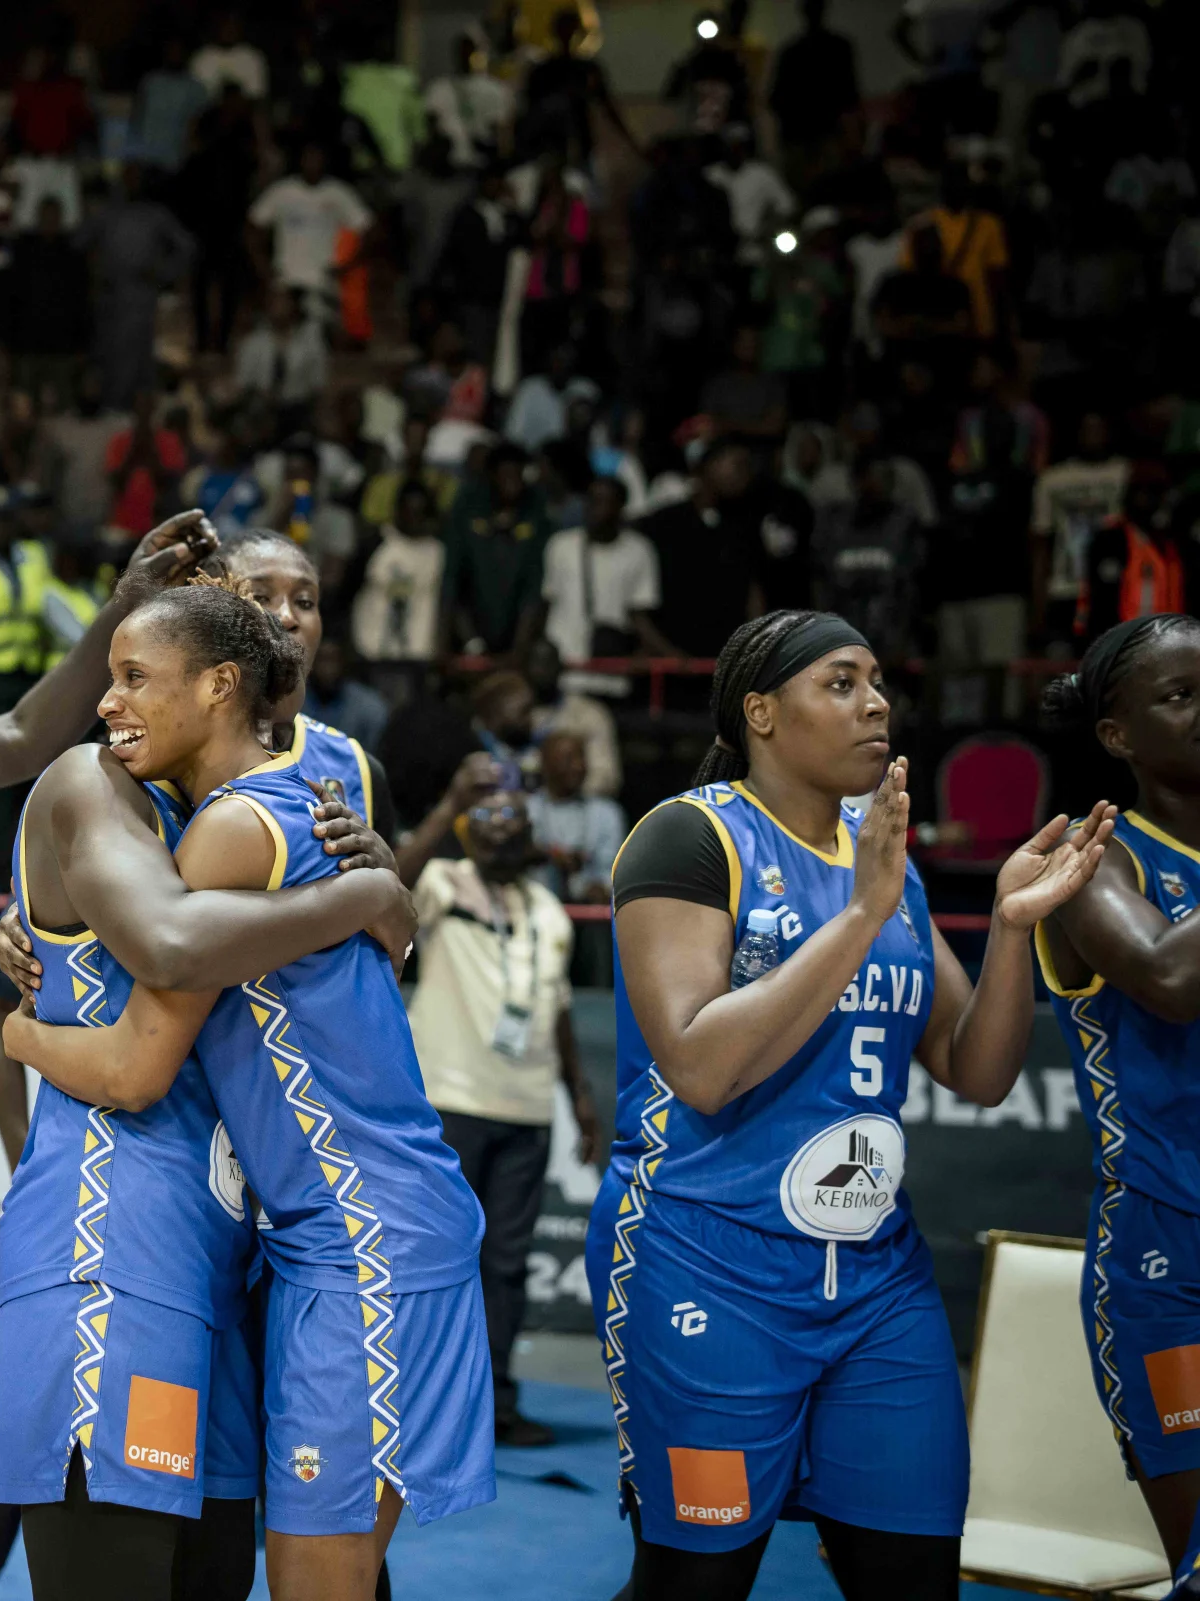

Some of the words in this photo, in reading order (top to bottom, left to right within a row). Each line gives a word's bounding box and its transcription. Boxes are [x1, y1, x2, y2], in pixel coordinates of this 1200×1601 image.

[850, 1026, 886, 1097] 5
[814, 1189, 889, 1209] KEBIMO
[128, 1445, 190, 1473] orange
[678, 1503, 743, 1523] orange
